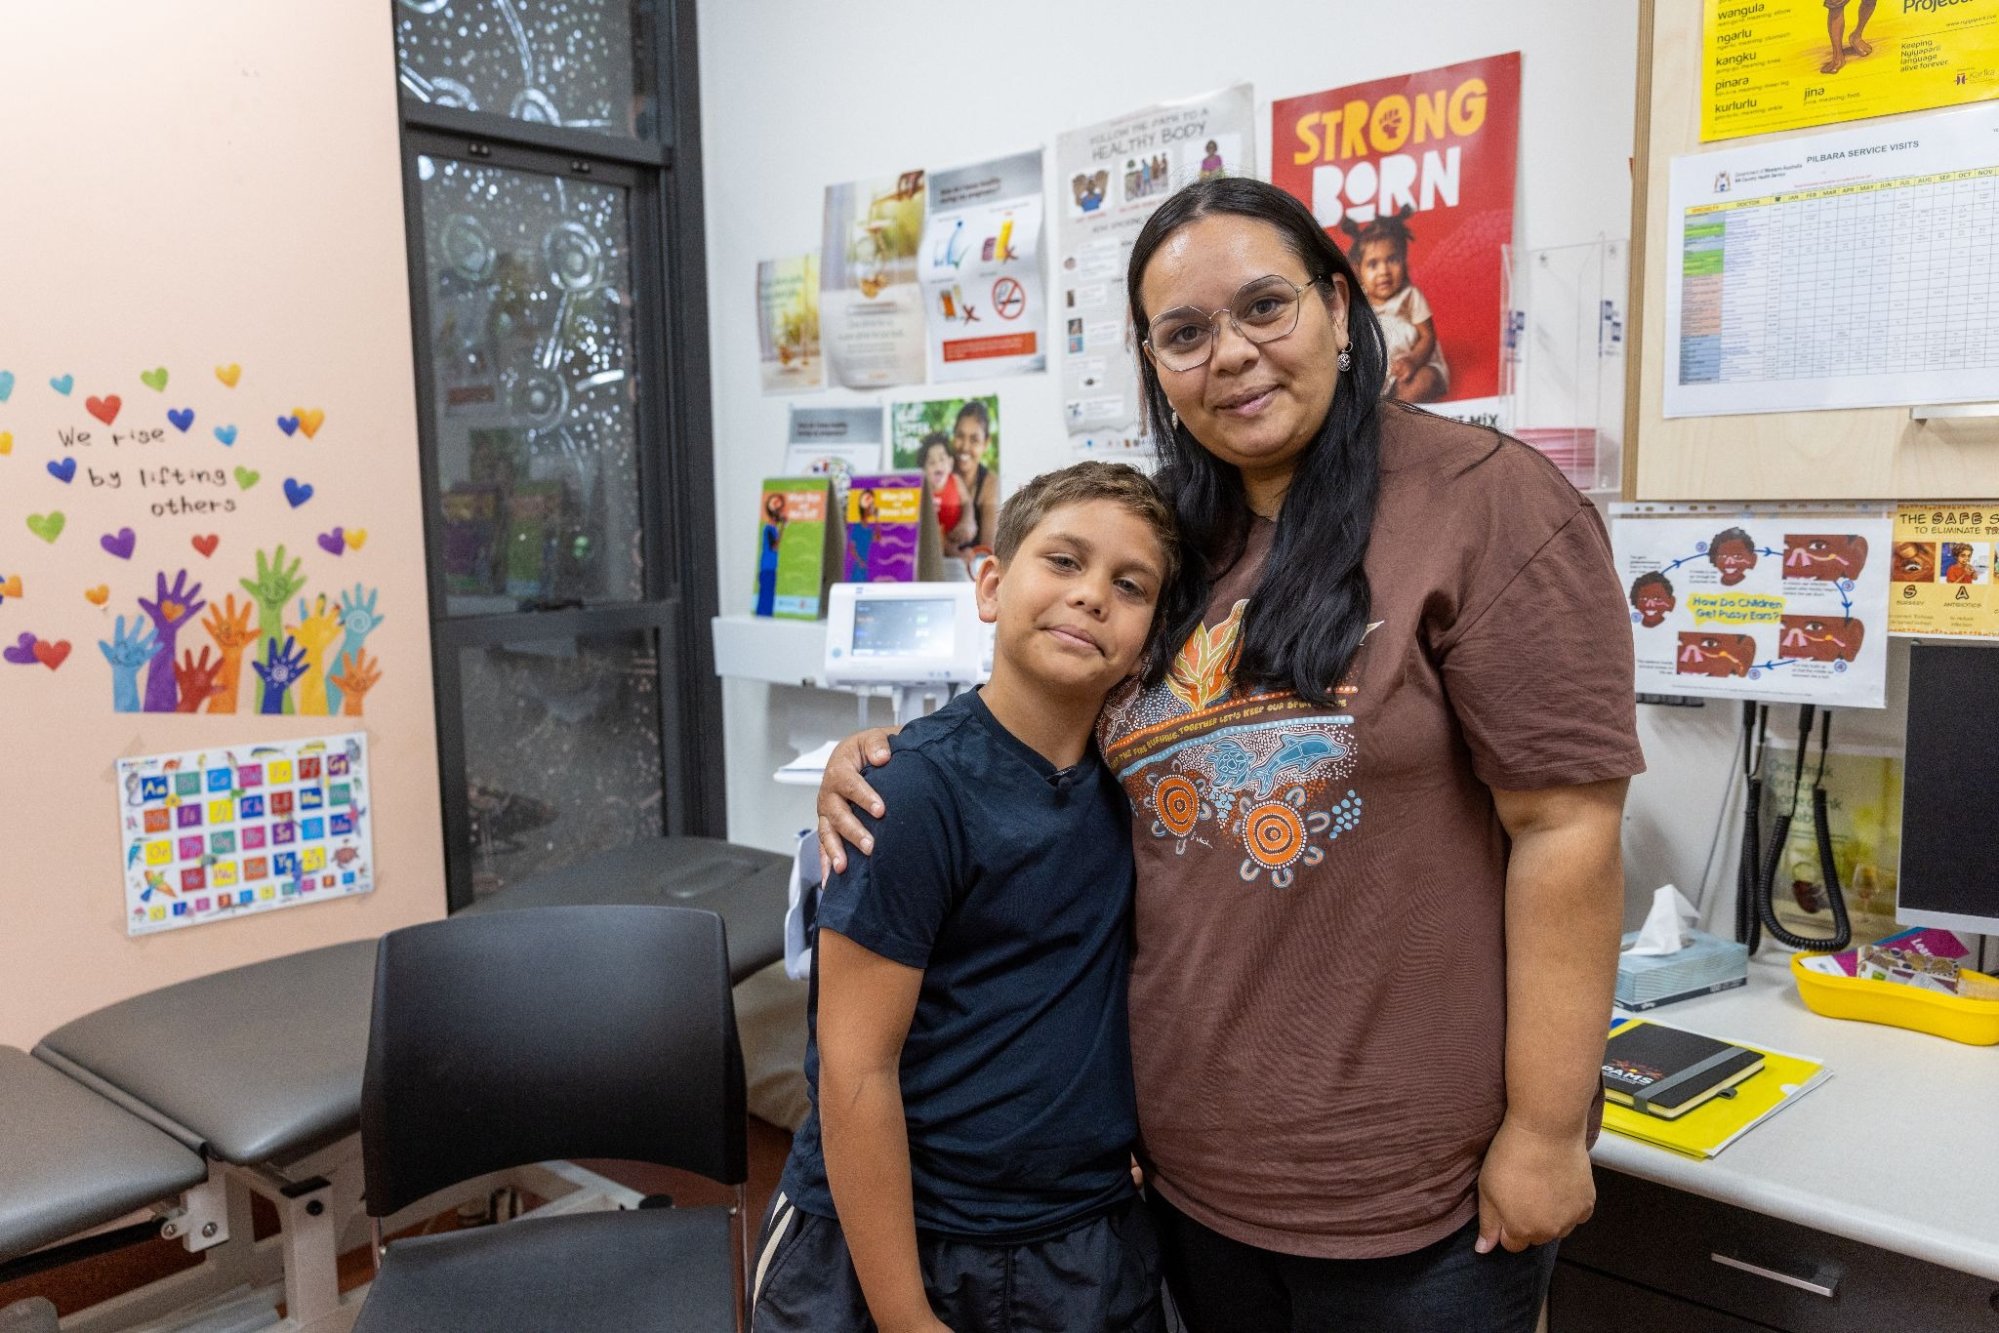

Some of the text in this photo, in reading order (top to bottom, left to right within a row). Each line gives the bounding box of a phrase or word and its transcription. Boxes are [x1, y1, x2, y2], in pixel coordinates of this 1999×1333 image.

[1718, 3, 1765, 20] wangula
[1717, 29, 1752, 44] ngarlu
[1901, 40, 1933, 50] Keeping
[1716, 52, 1757, 66] kangku
[1900, 54, 1937, 65] language
[1900, 64, 1919, 72] alive
[1715, 77, 1749, 91] pinara
[1804, 87, 1825, 100] jina
[1715, 98, 1757, 113] kurlurlu
[1294, 78, 1488, 165] STRONG
[1092, 121, 1206, 161] HEALTHY BODY
[1806, 140, 1920, 163] PILBARA SERVICE VISITS
[1312, 146, 1461, 228] BORN
[58, 426, 165, 447] We rise
[88, 465, 227, 488] by lifting
[151, 496, 237, 517] others
[1900, 514, 1926, 524] THE
[1932, 512, 1983, 525] SAFE
[1931, 527, 1980, 535] ELIMINATE
[1903, 584, 1917, 599] S
[1956, 585, 1970, 600] A
[1693, 597, 1782, 609] How Do Children
[1696, 609, 1716, 618] Get
[1750, 611, 1779, 620] Ears?
[1180, 718, 1217, 733] TOGETHER
[1219, 711, 1241, 723] LET'S
[1243, 706, 1264, 717] KEEP
[1267, 702, 1284, 712] OUR
